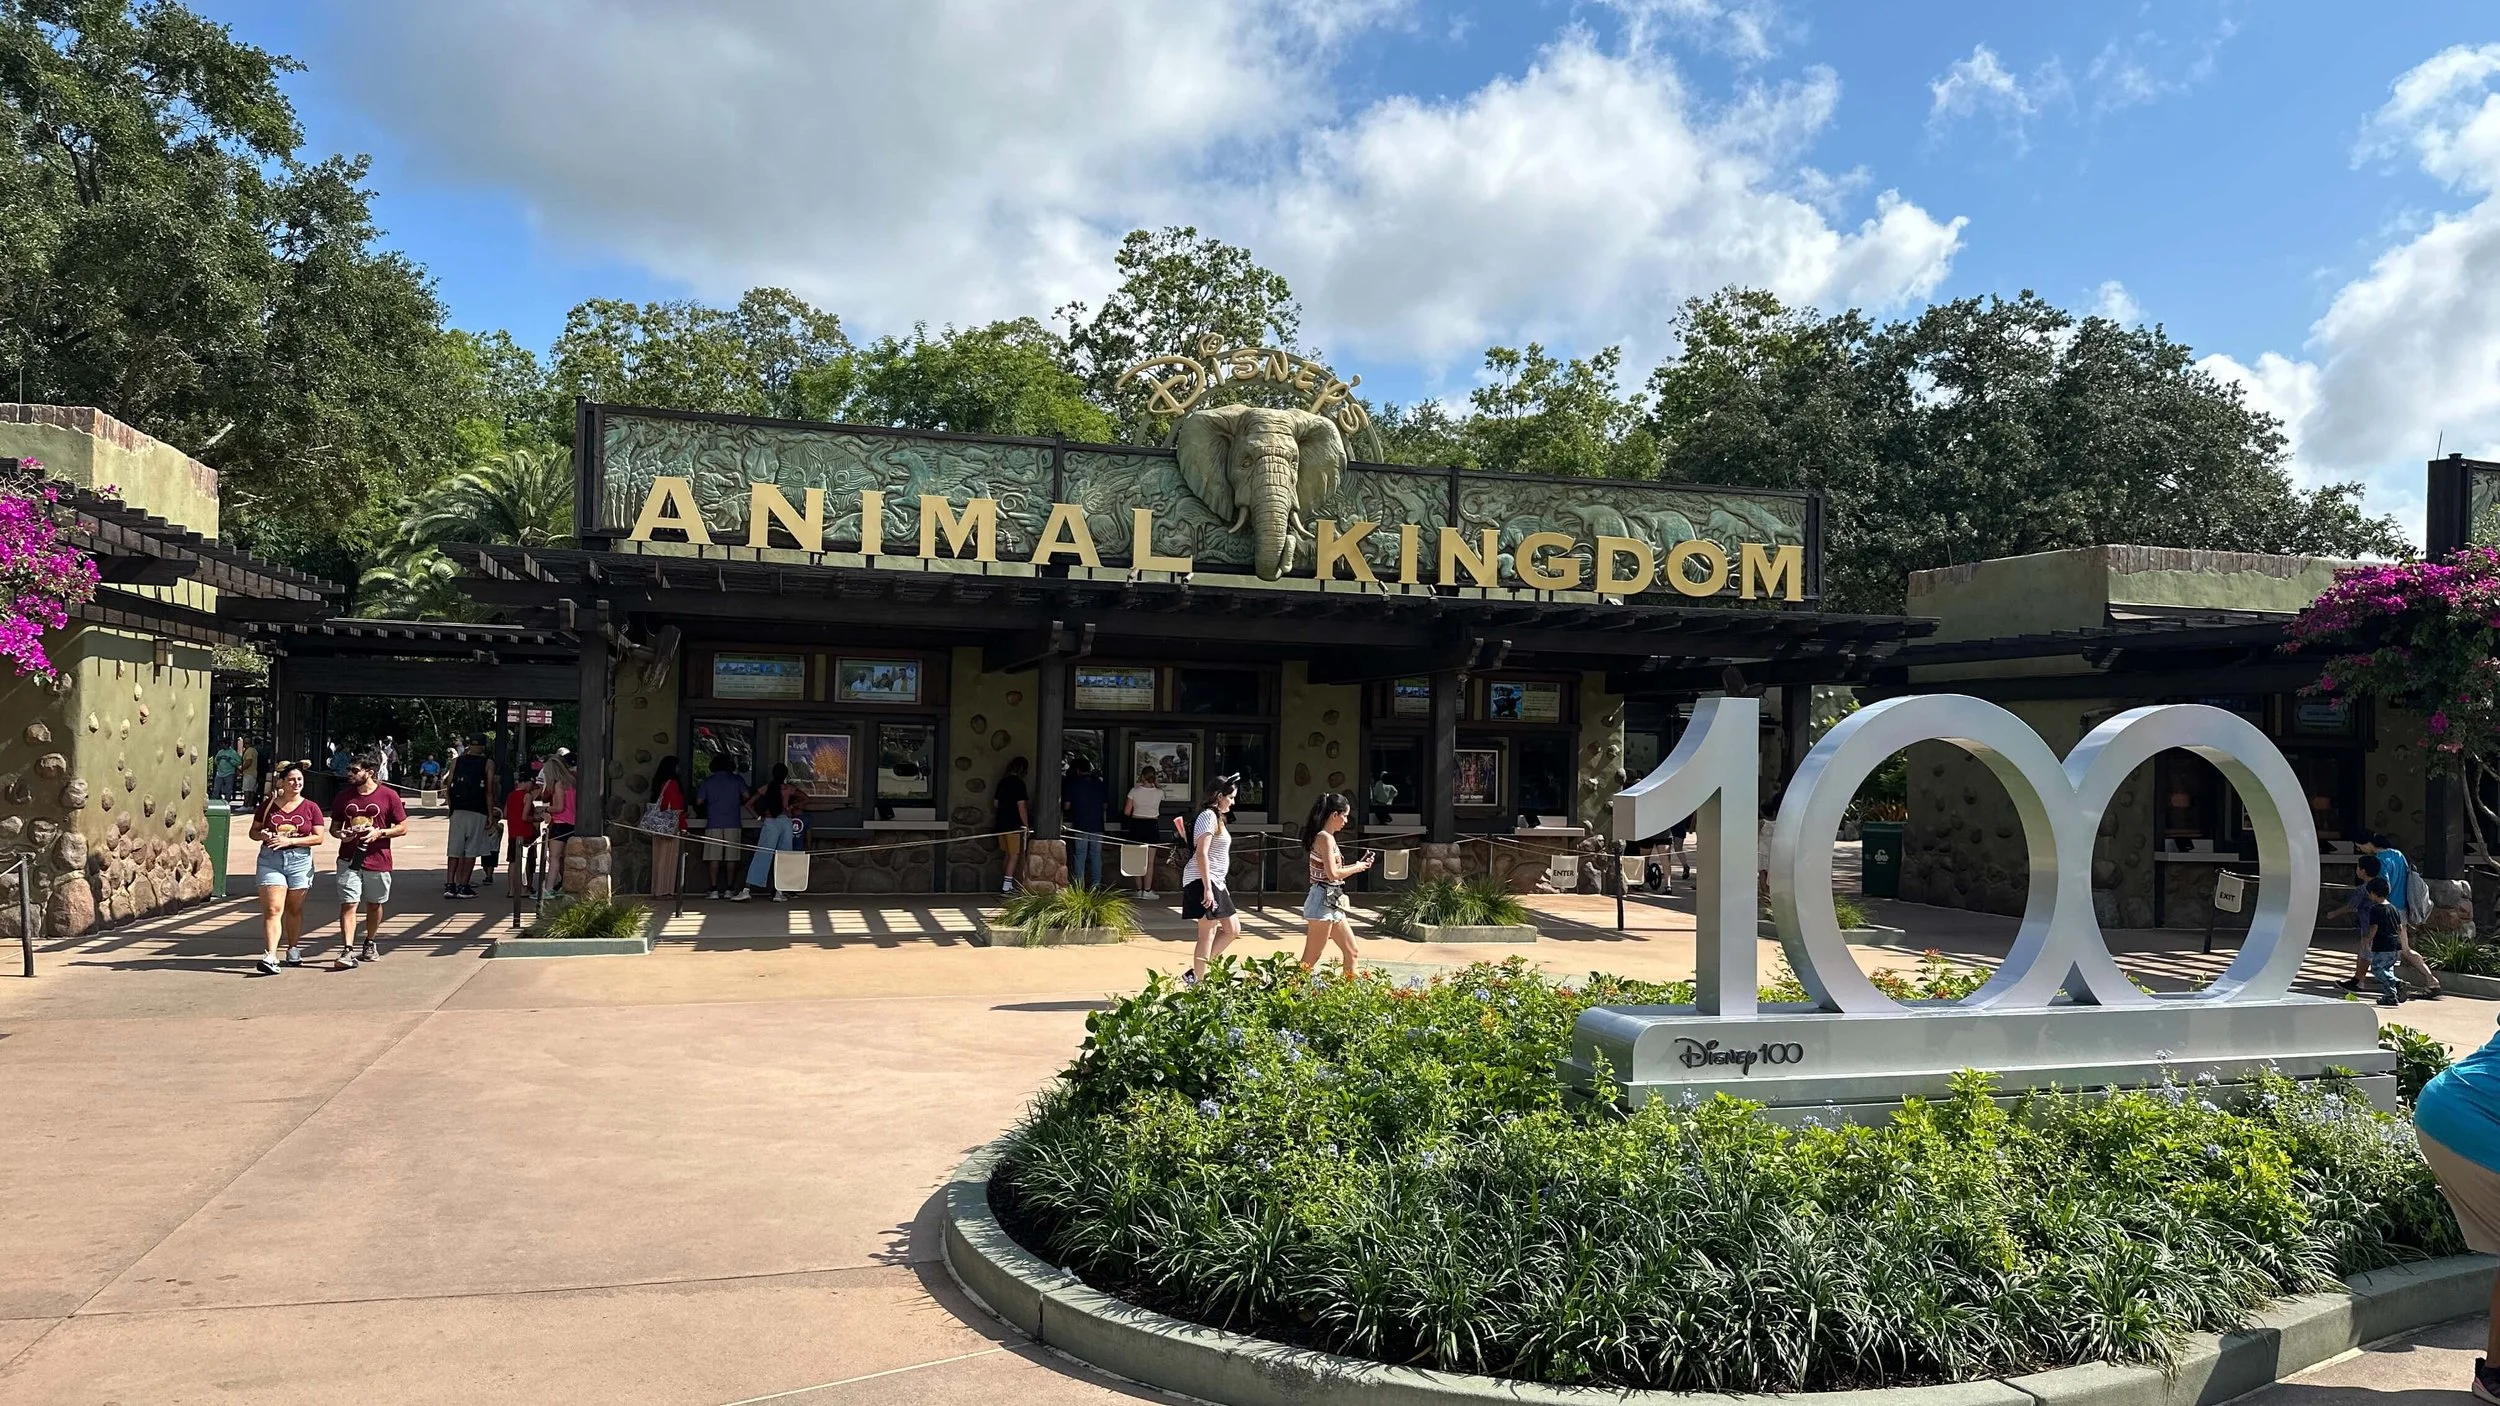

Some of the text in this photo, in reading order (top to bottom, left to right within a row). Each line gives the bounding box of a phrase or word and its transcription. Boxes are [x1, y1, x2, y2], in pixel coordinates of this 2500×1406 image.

[627, 475, 1805, 603] ANIMAL KINGDOM
[1553, 869, 1574, 877] ENTER
[1613, 693, 2320, 1016] 100
[2219, 891, 2236, 902] EXIT
